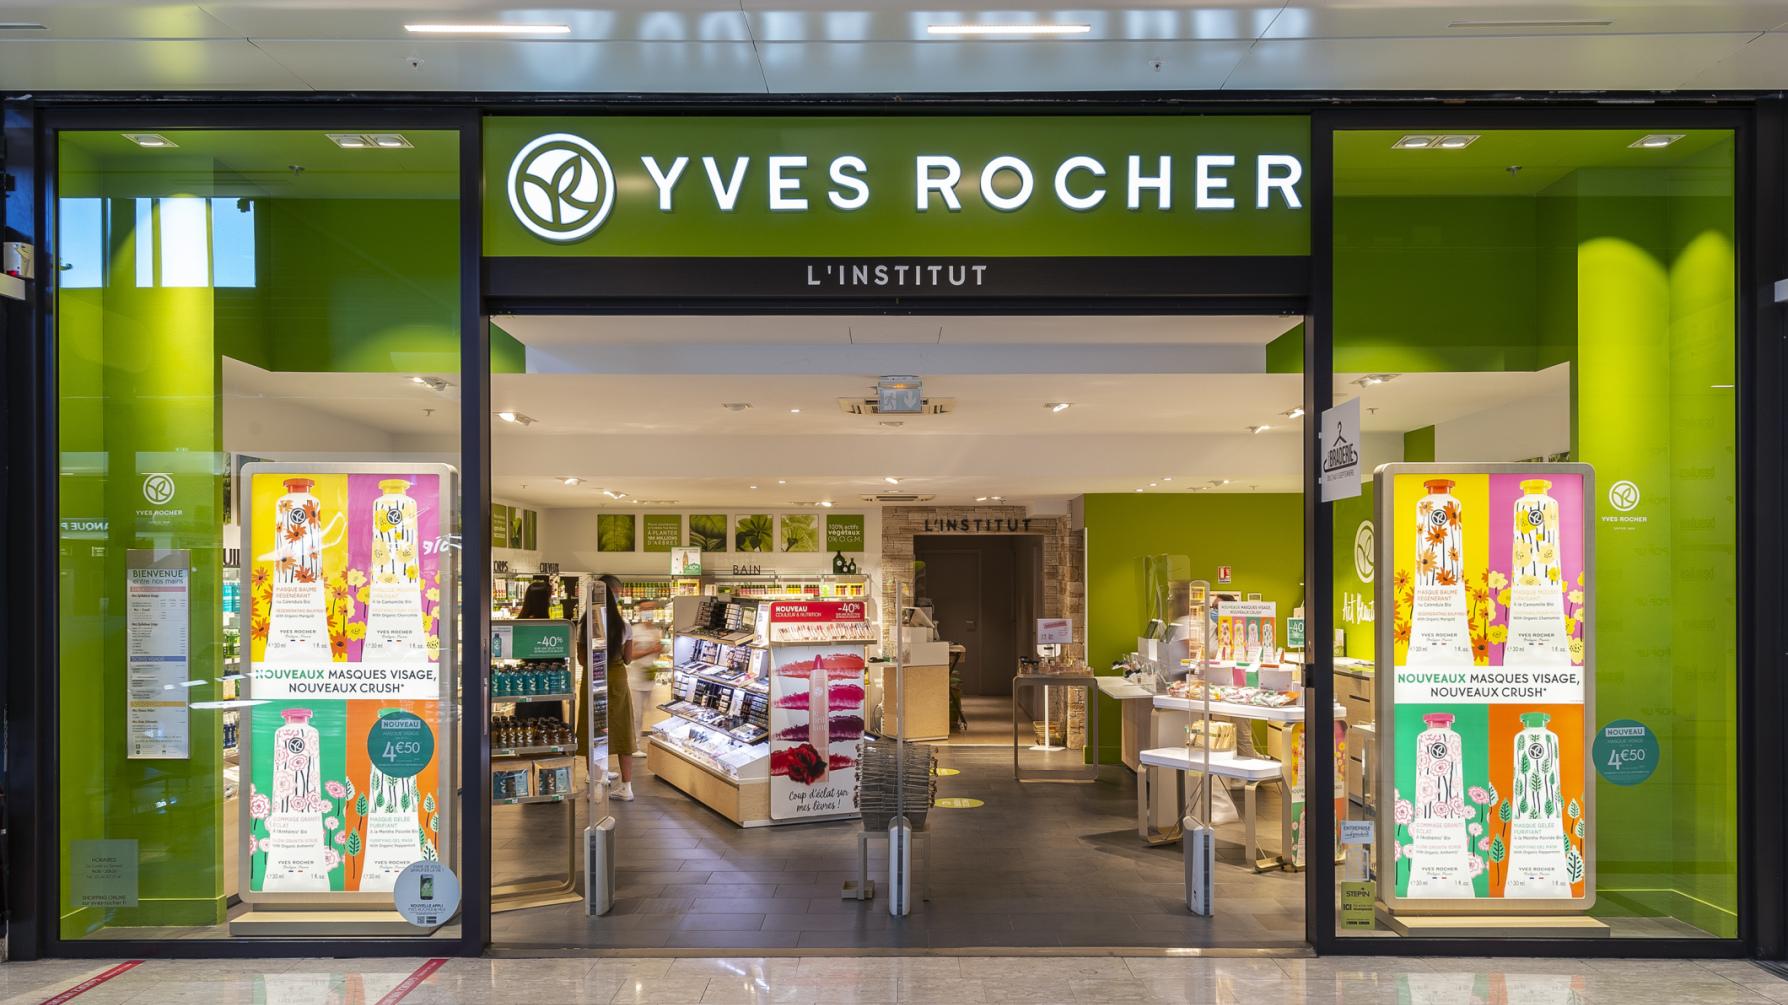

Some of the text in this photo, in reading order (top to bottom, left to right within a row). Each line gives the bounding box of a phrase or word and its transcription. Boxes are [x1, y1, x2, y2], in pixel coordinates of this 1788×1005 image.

[641, 154, 1304, 213] YVES ROCHER
[807, 265, 988, 286] L'INSTITUT
[1329, 443, 1354, 467] BRADERIE
[925, 518, 1032, 532] L'INSTITUT
[132, 569, 184, 578] BIENVENUE
[733, 565, 761, 575] BAIN
[837, 602, 860, 613] -40%
[537, 635, 564, 648] -40%
[328, 669, 387, 681] MASQUES
[390, 669, 437, 682] VISAGE,
[1398, 673, 1580, 686] NOUVEAUX MASQUES VISAGE,
[289, 683, 357, 694] NOUVEAUX
[1430, 686, 1499, 698] NOUVEAUX
[1607, 728, 1643, 736] NOUVEAU
[382, 741, 421, 763] 4€50
[1608, 749, 1646, 771] 4€50
[789, 787, 848, 803] Coup d'éclat sur
[797, 803, 811, 812] mes
[813, 800, 836, 811] lèvres
